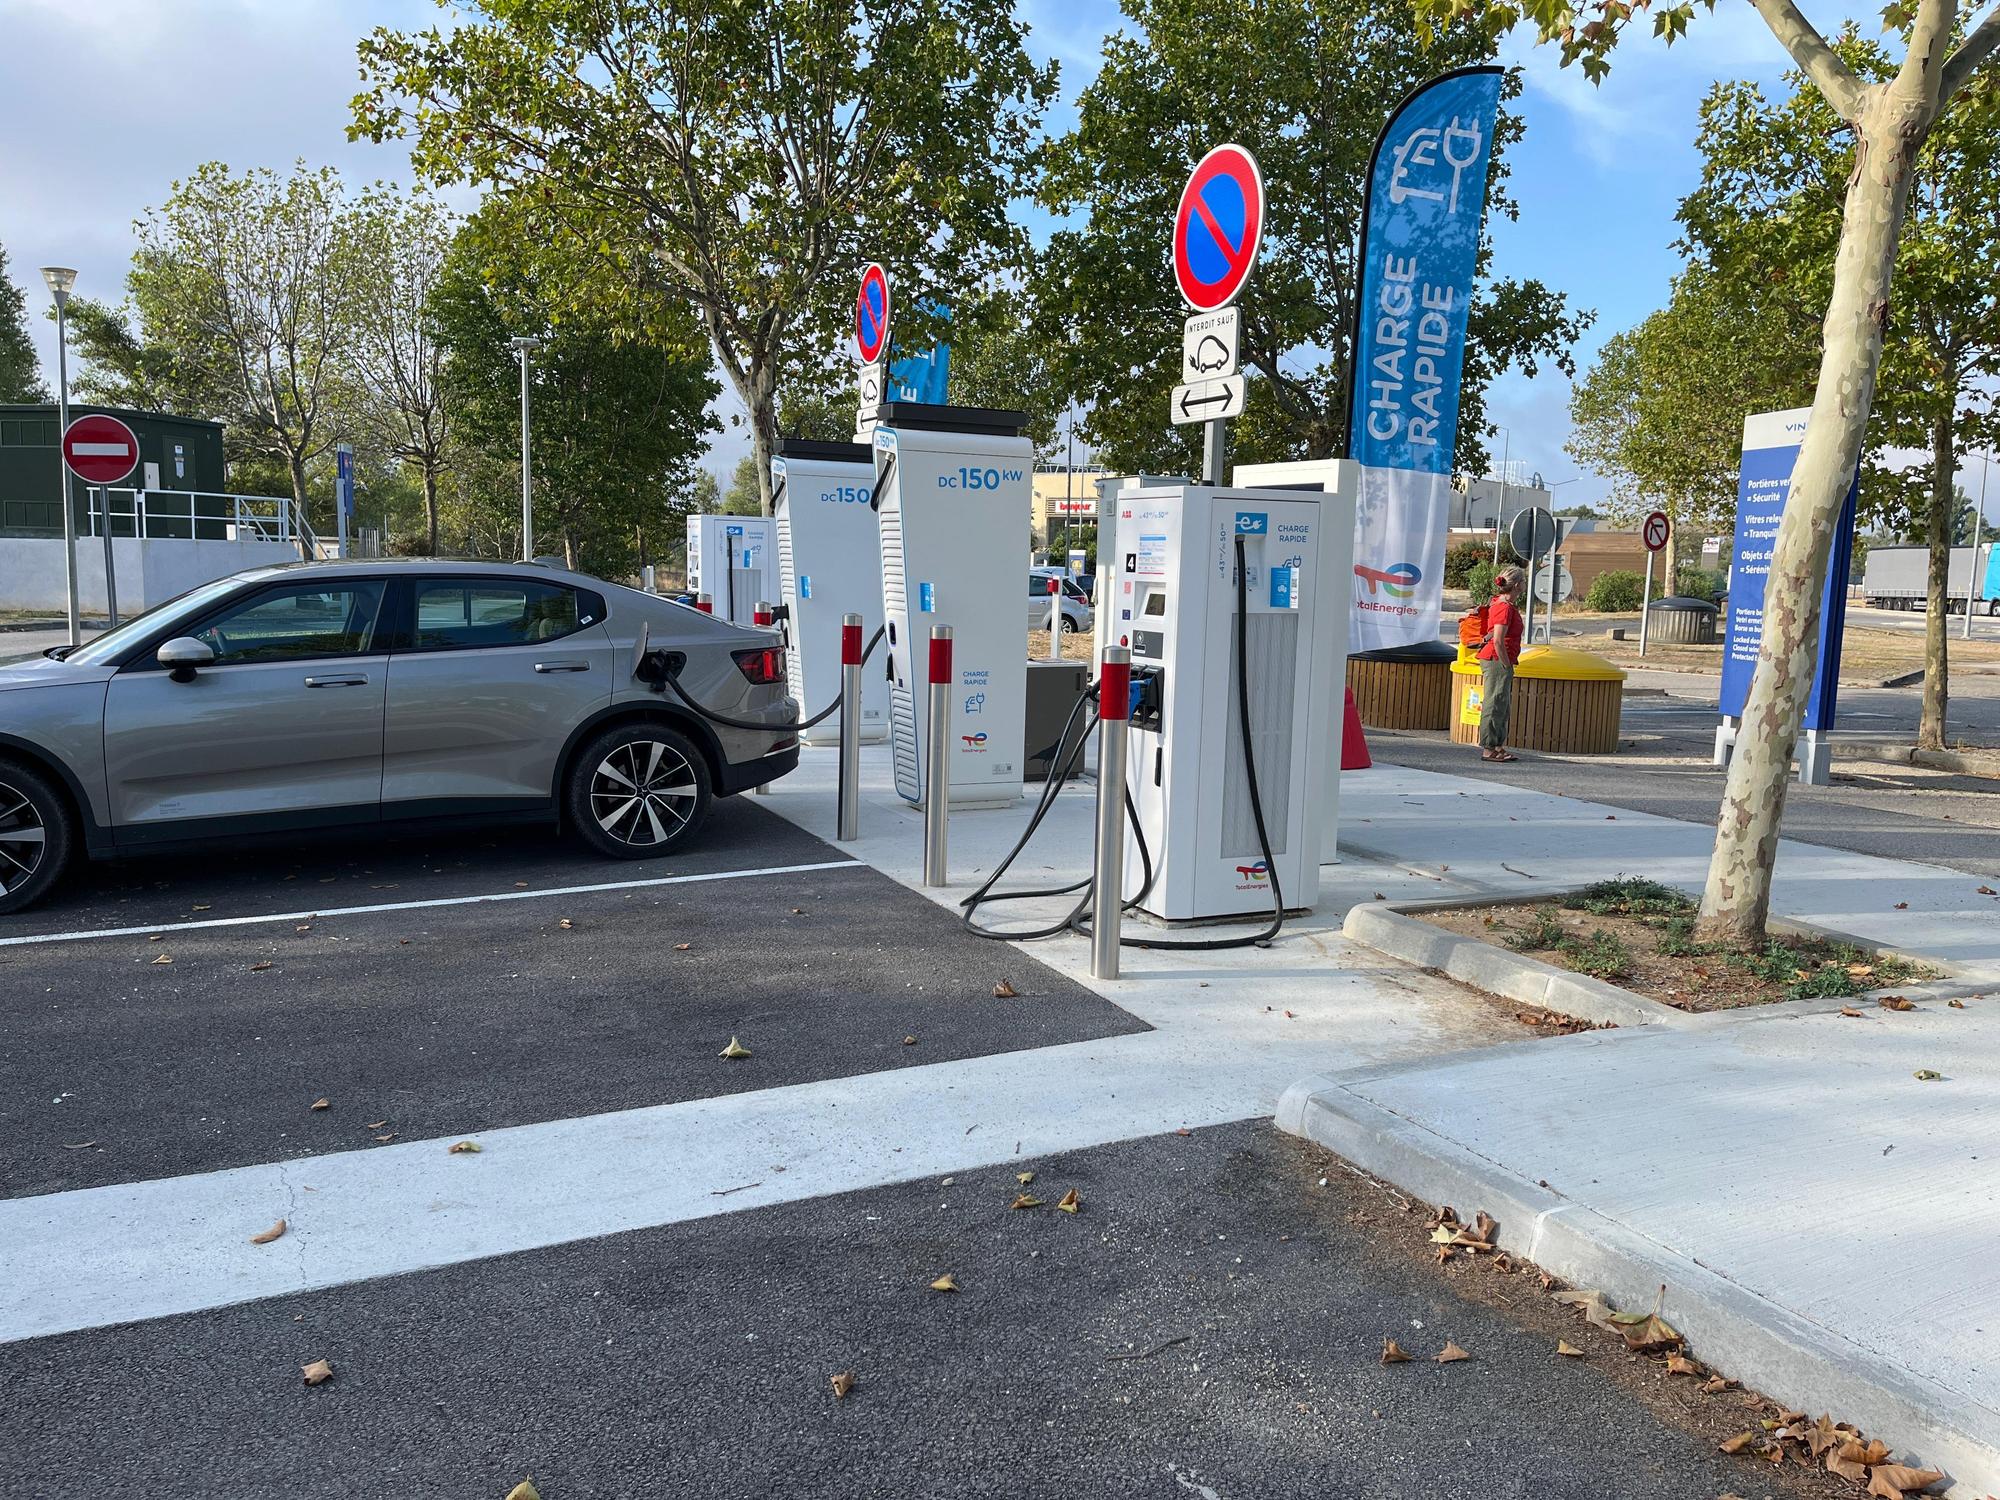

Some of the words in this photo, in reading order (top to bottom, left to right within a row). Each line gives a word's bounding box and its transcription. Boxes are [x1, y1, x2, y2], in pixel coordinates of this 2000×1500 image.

[1186, 319, 1215, 334] INTERDIT
[1217, 314, 1235, 327] SAUF
[1367, 253, 1416, 441] CHARGE
[1407, 282, 1454, 446] RAPIDE
[1785, 422, 1806, 431] VIN
[958, 467, 1000, 490] 150
[1003, 470, 1023, 482] kW
[1747, 478, 1779, 489] Portières
[1752, 492, 1780, 503] Sécurité
[1745, 514, 1765, 524] Vitres
[1765, 513, 1782, 523] relev
[1277, 524, 1309, 533] CHARGE
[1279, 535, 1307, 543] RAPIDE
[1741, 550, 1763, 562] Objets
[1127, 556, 1134, 570] 4
[1745, 564, 1770, 574] Sérénit
[1357, 600, 1418, 616] talEnergies
